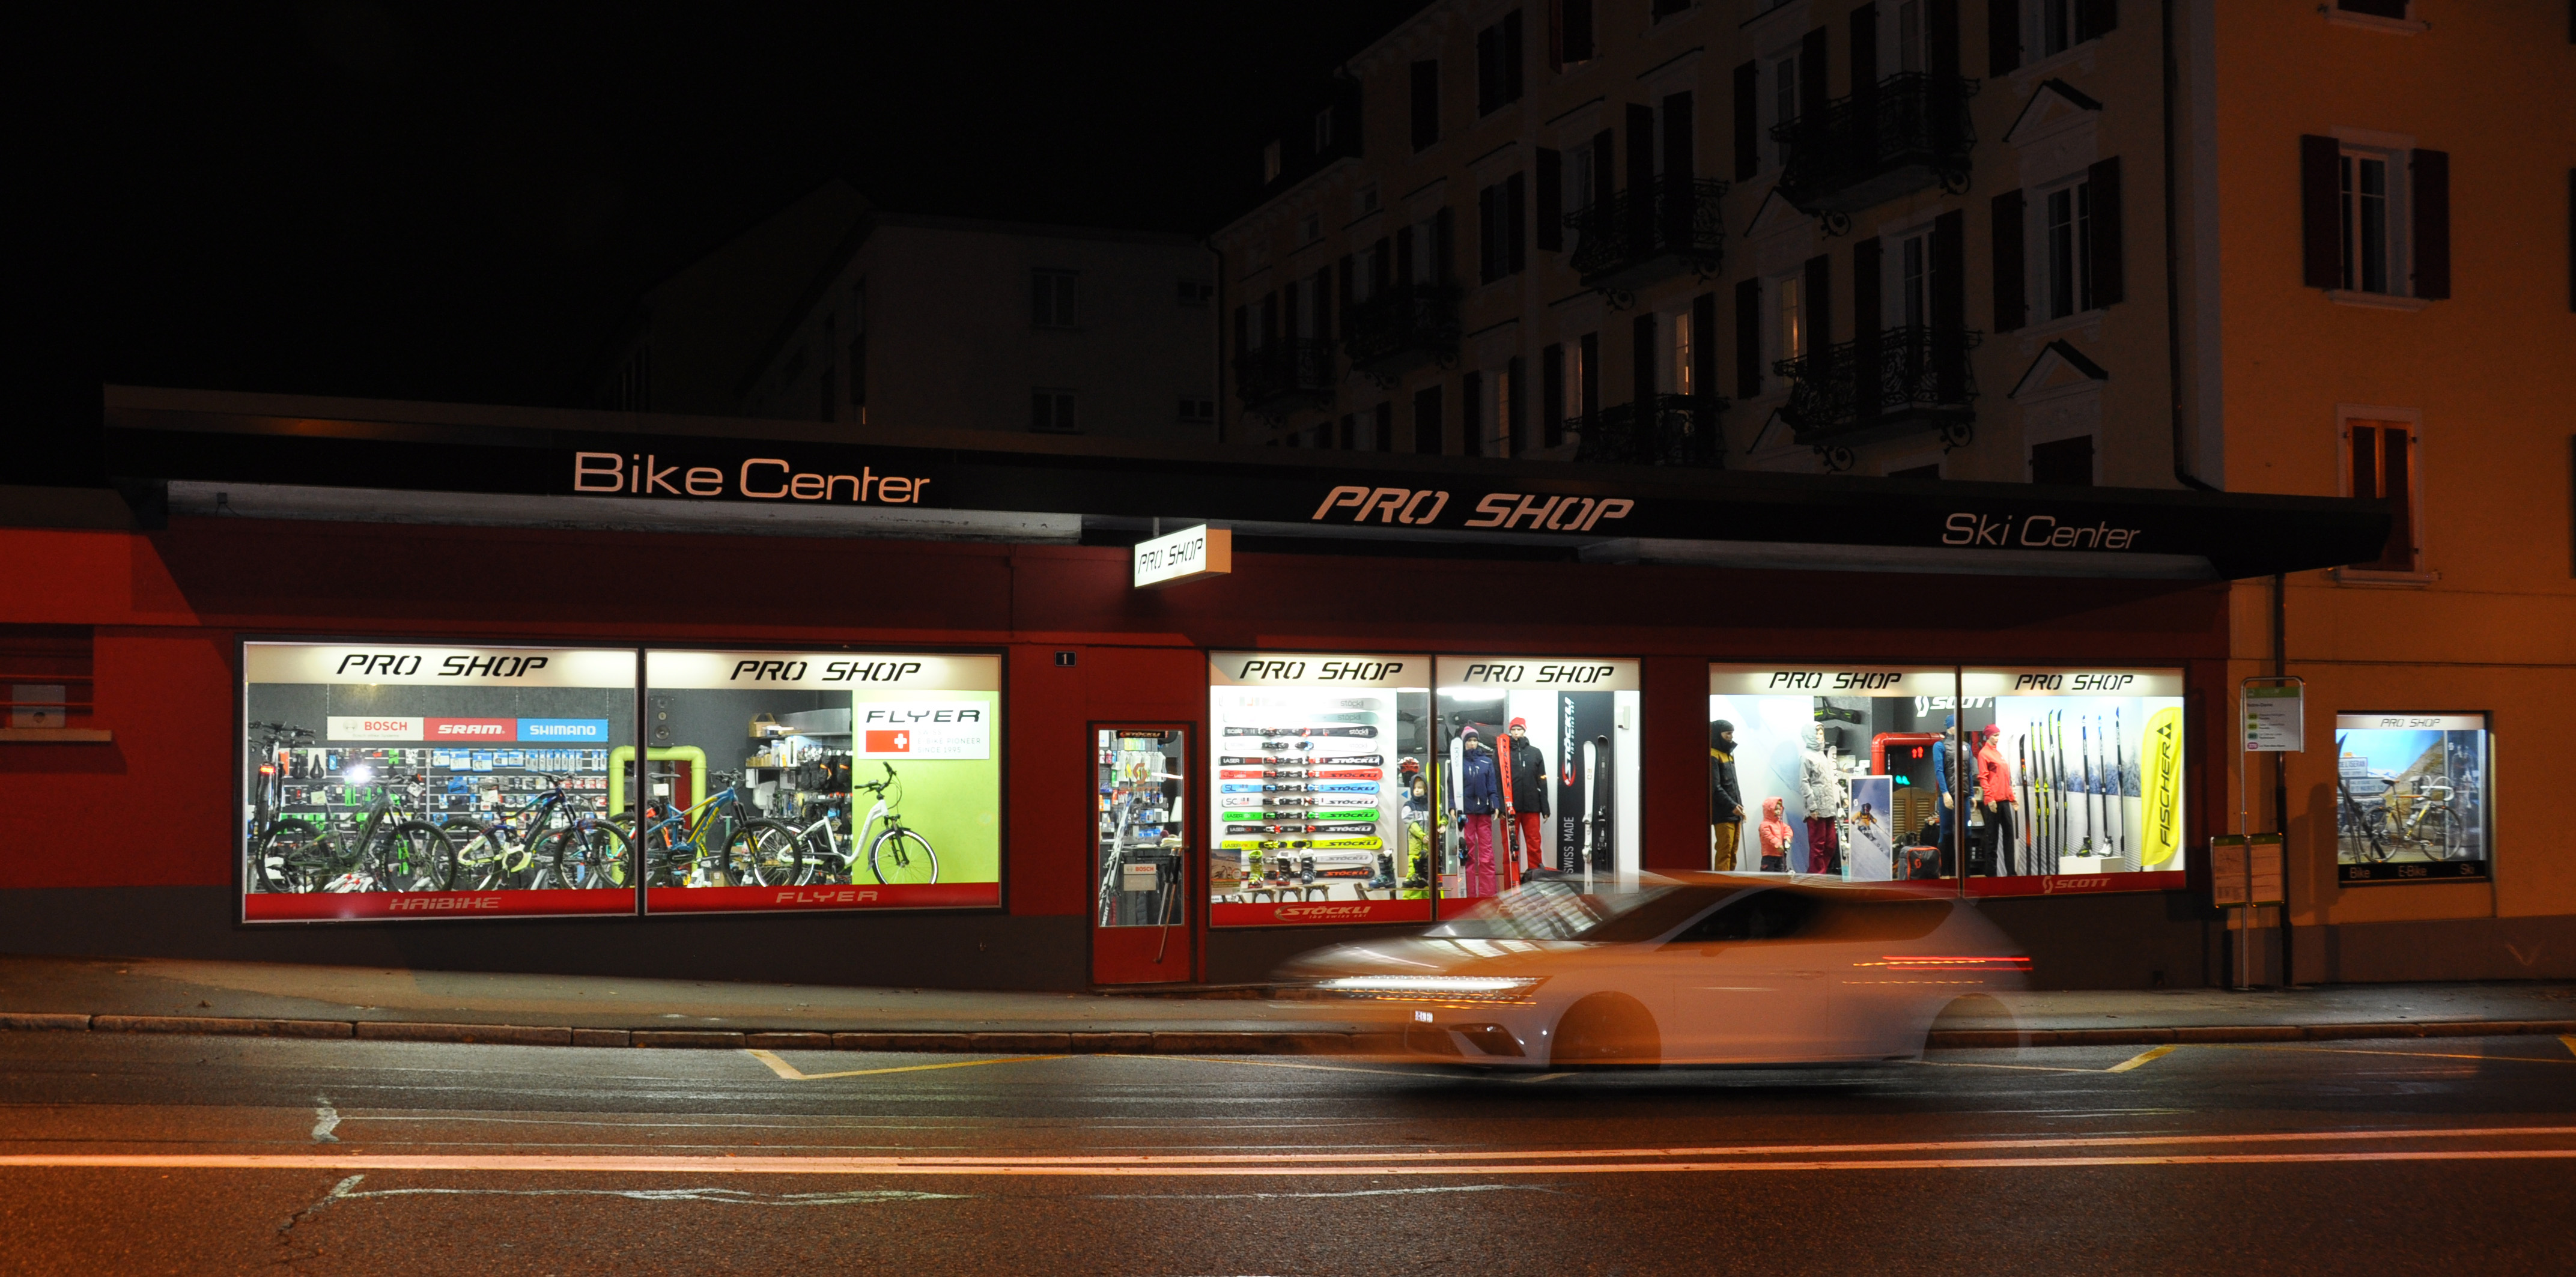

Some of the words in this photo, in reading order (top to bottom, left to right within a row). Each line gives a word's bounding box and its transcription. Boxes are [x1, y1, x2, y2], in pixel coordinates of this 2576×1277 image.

[574, 452, 723, 496] Bike
[740, 458, 930, 503] Center
[1311, 486, 1450, 524] PRO
[1464, 493, 1635, 532] SHOP
[1942, 512, 2012, 545] Ski
[2020, 515, 2141, 549] Center
[1138, 549, 1162, 574] PRO
[1168, 538, 1203, 566] SHOP
[336, 654, 422, 675] PRO
[437, 655, 548, 677] SHOP
[1062, 653, 1068, 664] 1
[730, 661, 807, 681] PRO
[822, 662, 922, 682] SHOP
[1239, 661, 1305, 679] PRO
[1318, 662, 1403, 681] SHOP
[1463, 664, 1523, 682] PRO
[1536, 666, 1614, 683] SHOP
[1769, 672, 1823, 689] PRO
[1832, 672, 1902, 689] SHOP
[2015, 674, 2062, 690] PRO
[2071, 675, 2134, 690] SHOP
[866, 709, 980, 723] FLYER
[2380, 718, 2404, 727] PRO
[2409, 718, 2441, 727] SHOP
[364, 721, 408, 731] BOSCH
[438, 724, 503, 735] SRAM
[530, 725, 596, 736] SHIMANO
[2160, 741, 2171, 848] FISCHER
[1563, 816, 1574, 842] MADE
[1563, 846, 1574, 874] SWISS
[2350, 867, 2371, 878] Bike
[2398, 866, 2427, 877] E-Bike
[2055, 878, 2111, 888] SCOTT
[389, 897, 502, 910] HAIBIKE
[776, 891, 879, 903] FLYER
[1281, 906, 1372, 916] STÖCKLI
